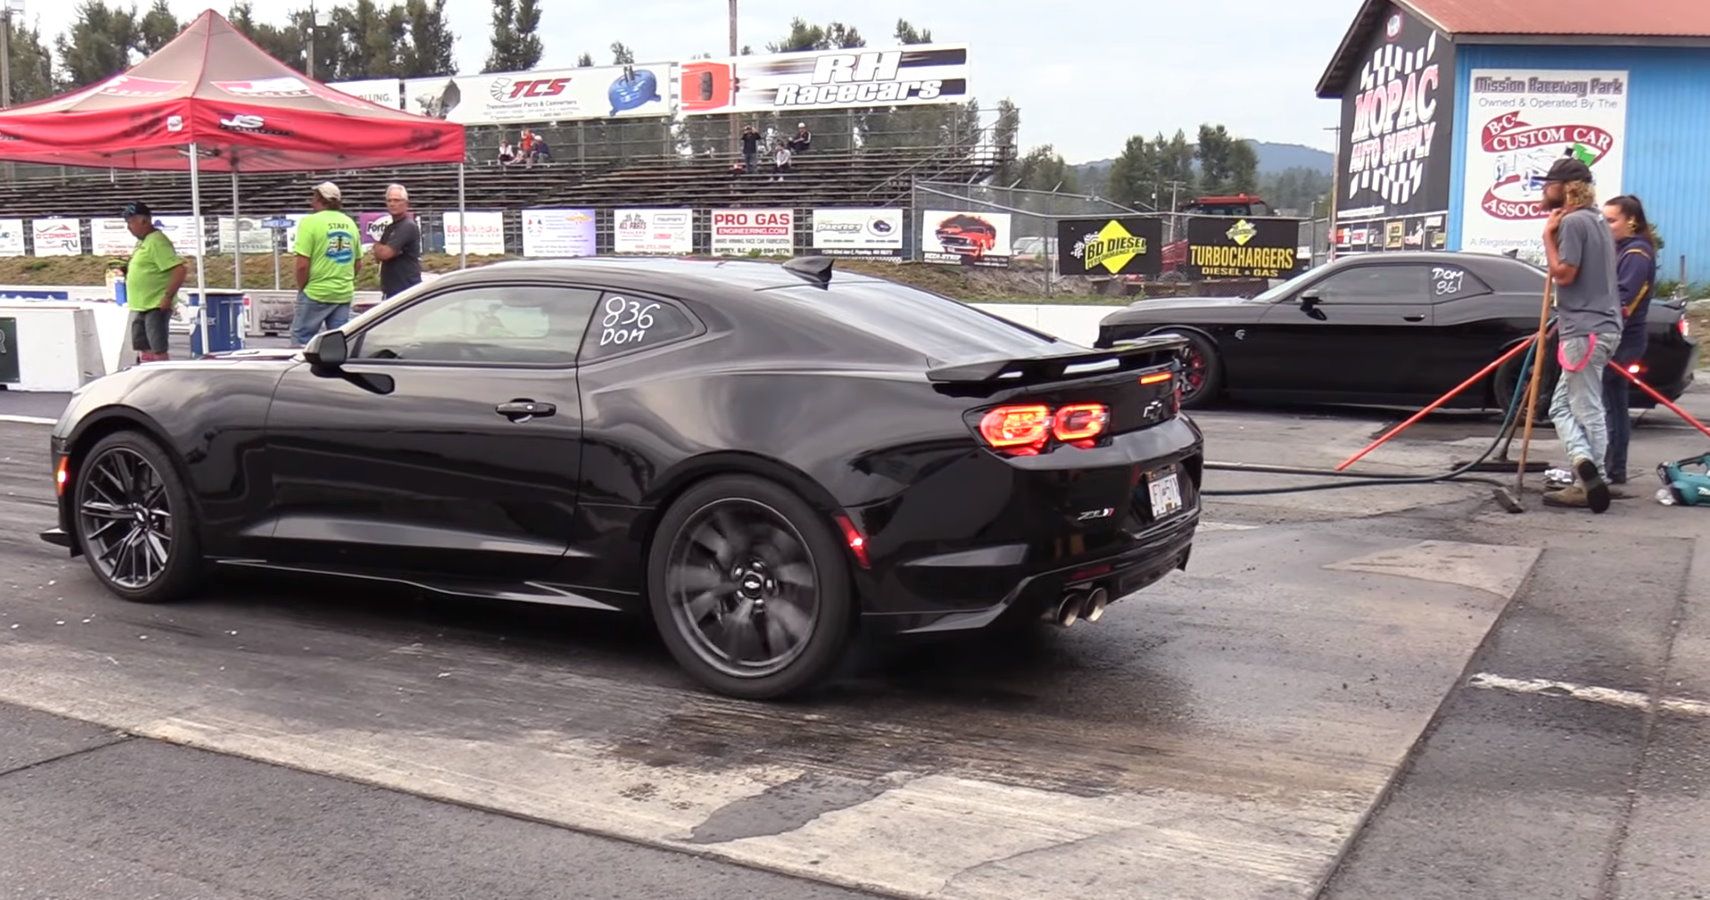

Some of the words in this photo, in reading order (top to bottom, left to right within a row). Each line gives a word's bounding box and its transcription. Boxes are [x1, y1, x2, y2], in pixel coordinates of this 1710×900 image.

[811, 51, 902, 85] RH
[509, 78, 572, 99] TCS
[774, 79, 942, 106] Racecars
[1474, 76, 1526, 94] Mission
[1527, 77, 1588, 98] Raceway
[1589, 77, 1624, 95] Park
[1351, 64, 1439, 143] MOPAC
[1479, 97, 1516, 108] Owned
[1518, 97, 1526, 108] &
[1530, 98, 1578, 109] Operated
[1581, 98, 1595, 109] By
[1599, 98, 1617, 108] The
[219, 113, 265, 129] JS
[1349, 138, 1381, 173] AUTO
[1382, 122, 1436, 167] SUPPLY
[1493, 127, 1565, 151] CUSTOM
[1573, 128, 1611, 151] CAR
[1484, 199, 1546, 217] ASSOC
[714, 213, 748, 225] PRO
[755, 213, 790, 225] GAS
[61, 239, 78, 251] RV
[1087, 241, 1104, 260] BD
[1107, 236, 1147, 252] DIESEL
[1479, 238, 1528, 248] Registered
[1190, 245, 1294, 269] TURBOCHARGERS
[1202, 267, 1242, 277] DIESEL
[1253, 268, 1279, 278] GAS
[1431, 267, 1464, 281] DOM
[603, 296, 660, 329] 836
[600, 328, 645, 346] DOM
